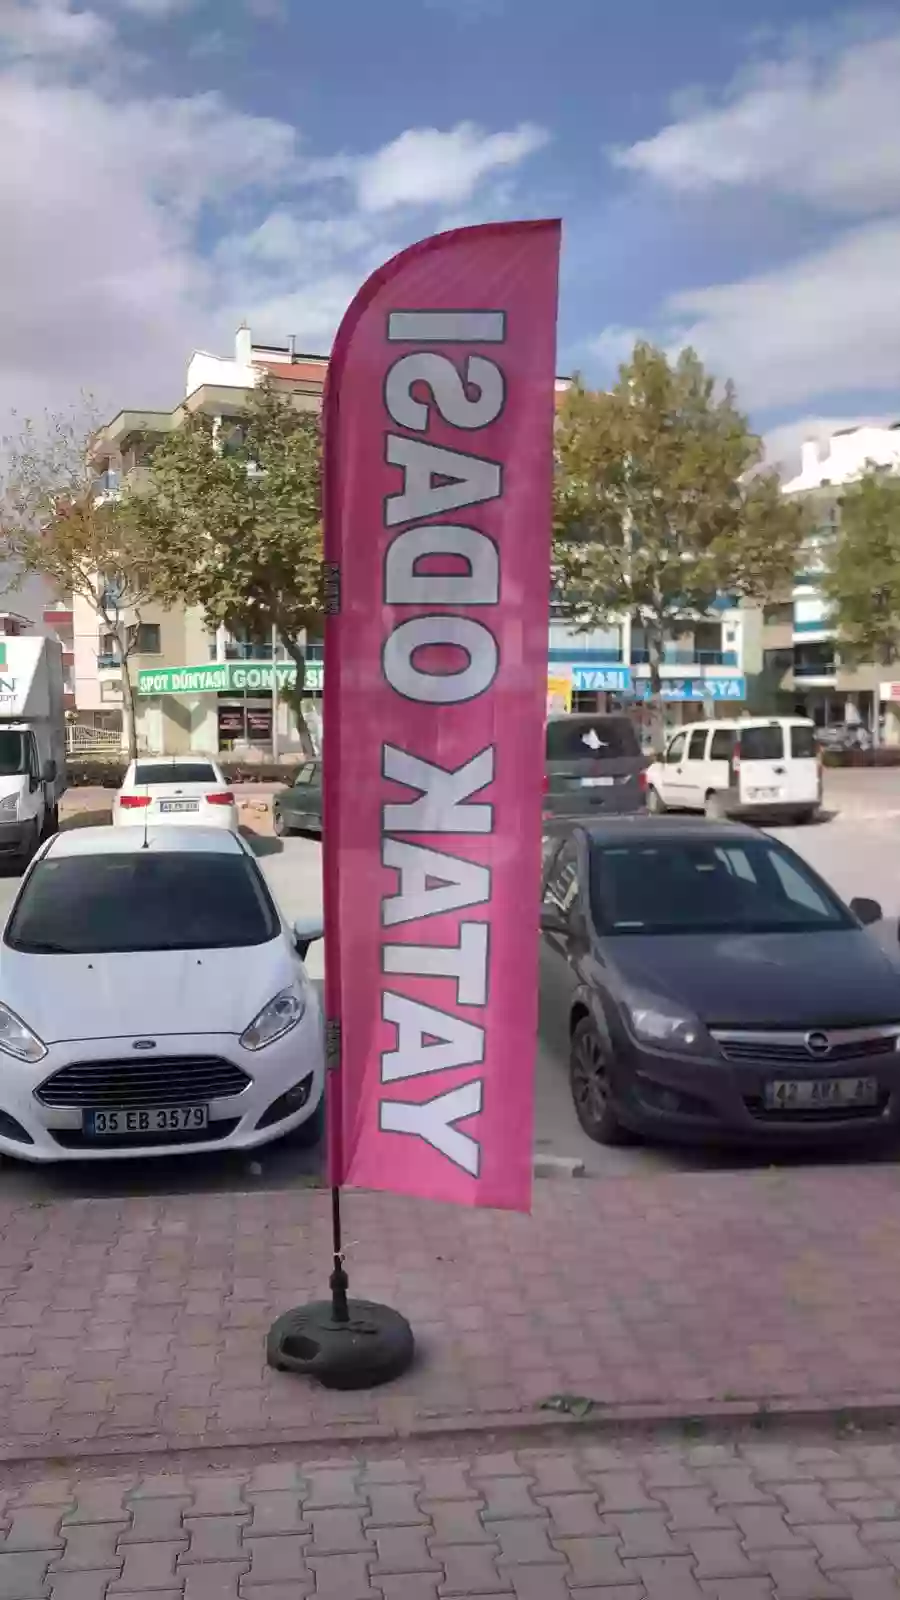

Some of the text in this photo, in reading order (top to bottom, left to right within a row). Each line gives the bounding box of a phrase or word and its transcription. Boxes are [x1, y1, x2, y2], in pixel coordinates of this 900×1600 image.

[140, 675, 169, 692] SPOT
[96, 1108, 204, 1131] 35 EB 3579
